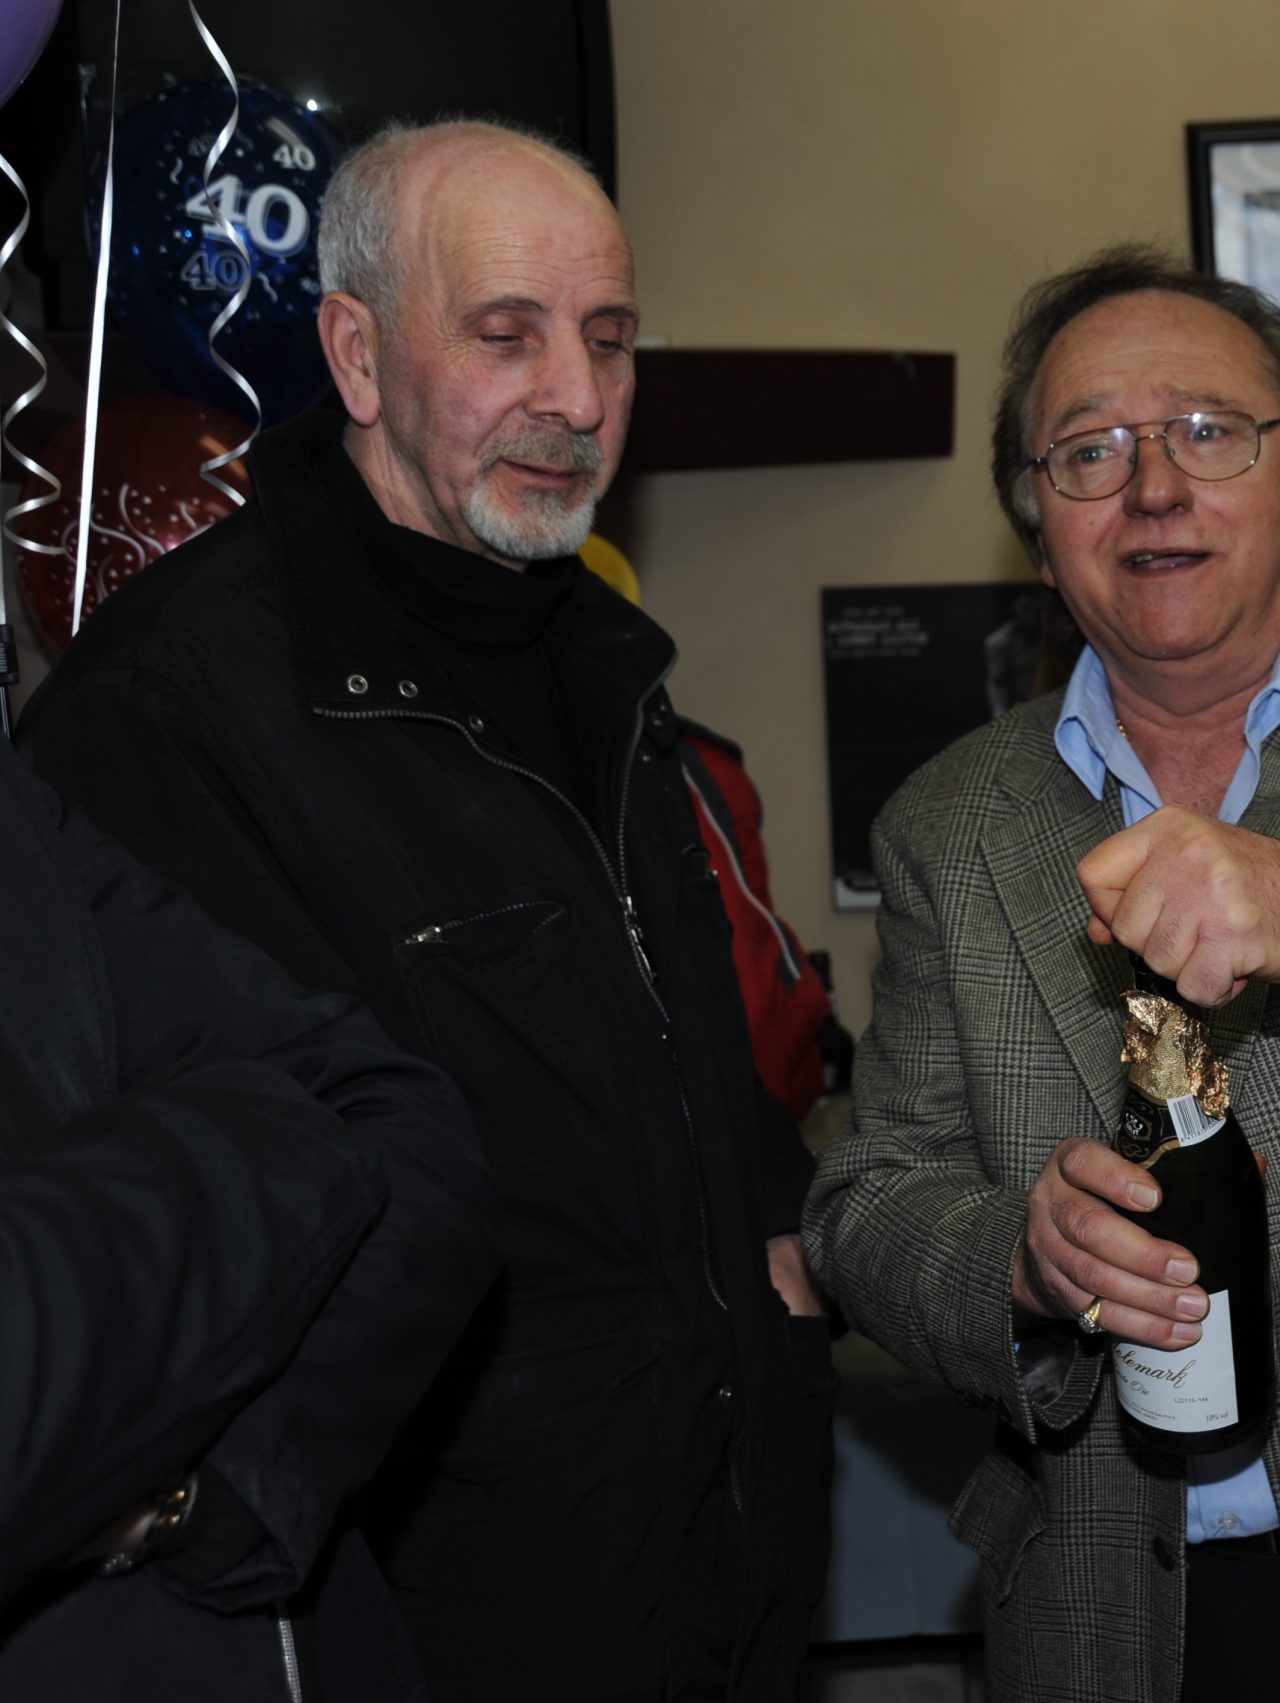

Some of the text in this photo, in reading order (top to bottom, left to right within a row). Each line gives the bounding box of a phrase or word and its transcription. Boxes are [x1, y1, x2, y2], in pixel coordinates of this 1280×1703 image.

[271, 143, 317, 172] 40
[184, 173, 311, 258] 40
[179, 249, 248, 292] 40
